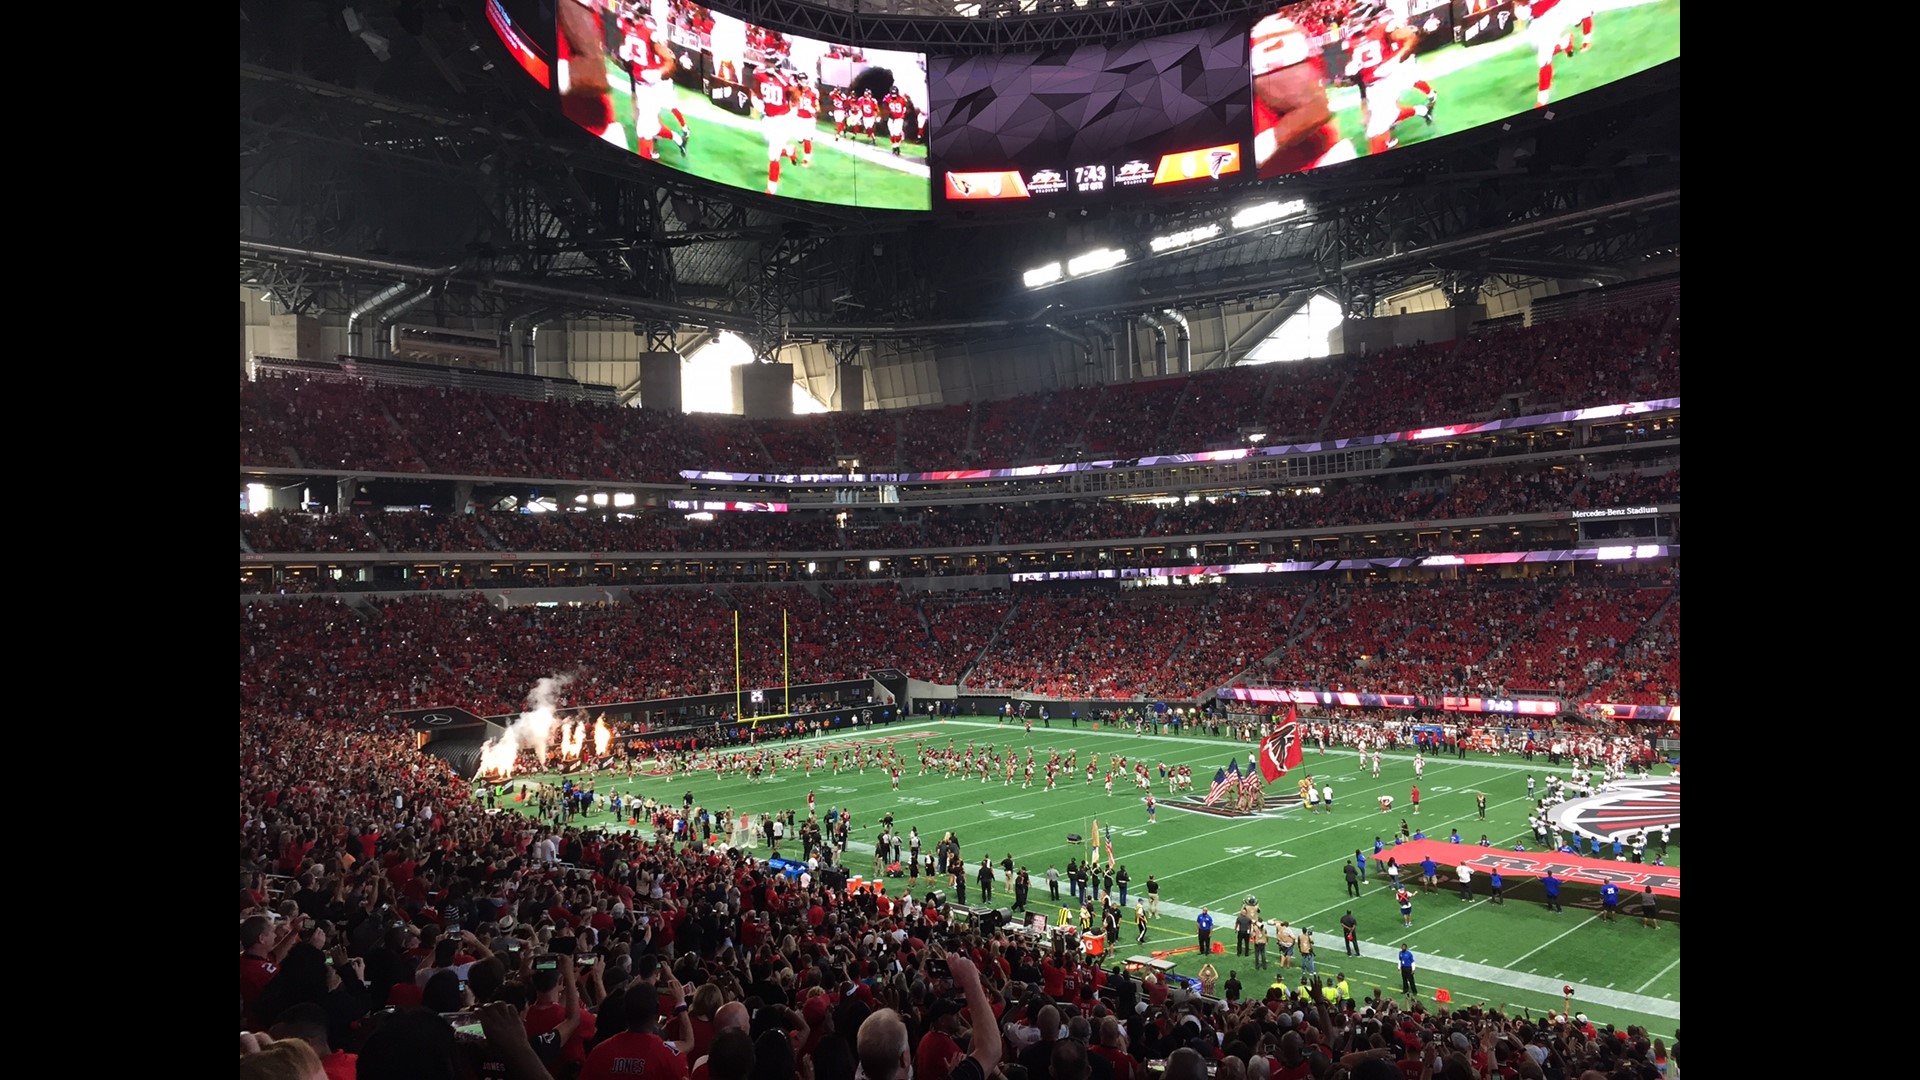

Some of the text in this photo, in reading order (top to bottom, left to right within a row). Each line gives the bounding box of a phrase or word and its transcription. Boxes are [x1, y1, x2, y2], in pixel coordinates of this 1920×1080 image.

[760, 82, 783, 106] 90
[1074, 165, 1107, 183] 7:43
[1572, 508, 1625, 518] Mercedes-Benz
[1626, 506, 1658, 514] Stadium
[751, 690, 763, 702] 25
[1223, 846, 1284, 858] 40
[1466, 854, 1680, 890] RISE
[1086, 940, 1094, 951] G
[482, 1061, 505, 1072] JONES
[610, 1057, 645, 1074] JONES
